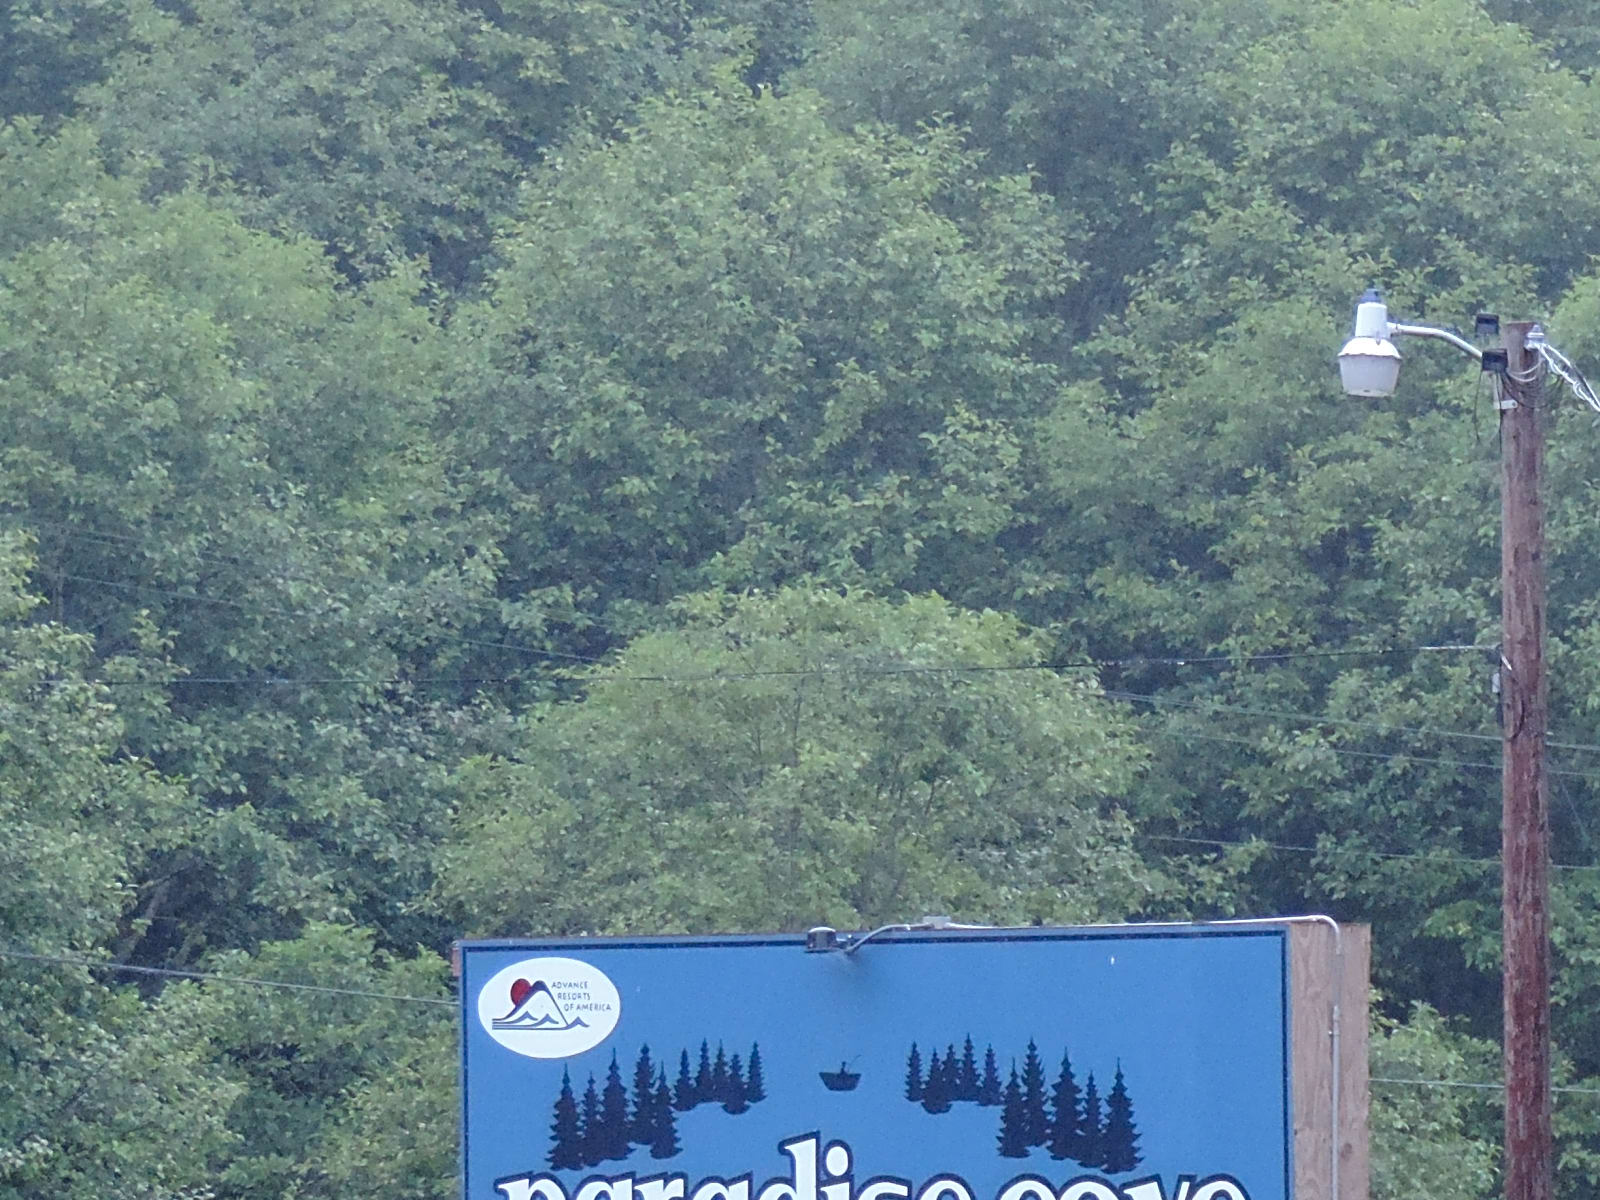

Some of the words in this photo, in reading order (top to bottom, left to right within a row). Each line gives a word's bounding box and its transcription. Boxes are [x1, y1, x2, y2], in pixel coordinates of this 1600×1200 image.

[551, 981, 588, 990] ADVANCE
[557, 992, 591, 1001] RESORTS
[563, 1003, 574, 1012] OF
[576, 1003, 612, 1012] AMERICA
